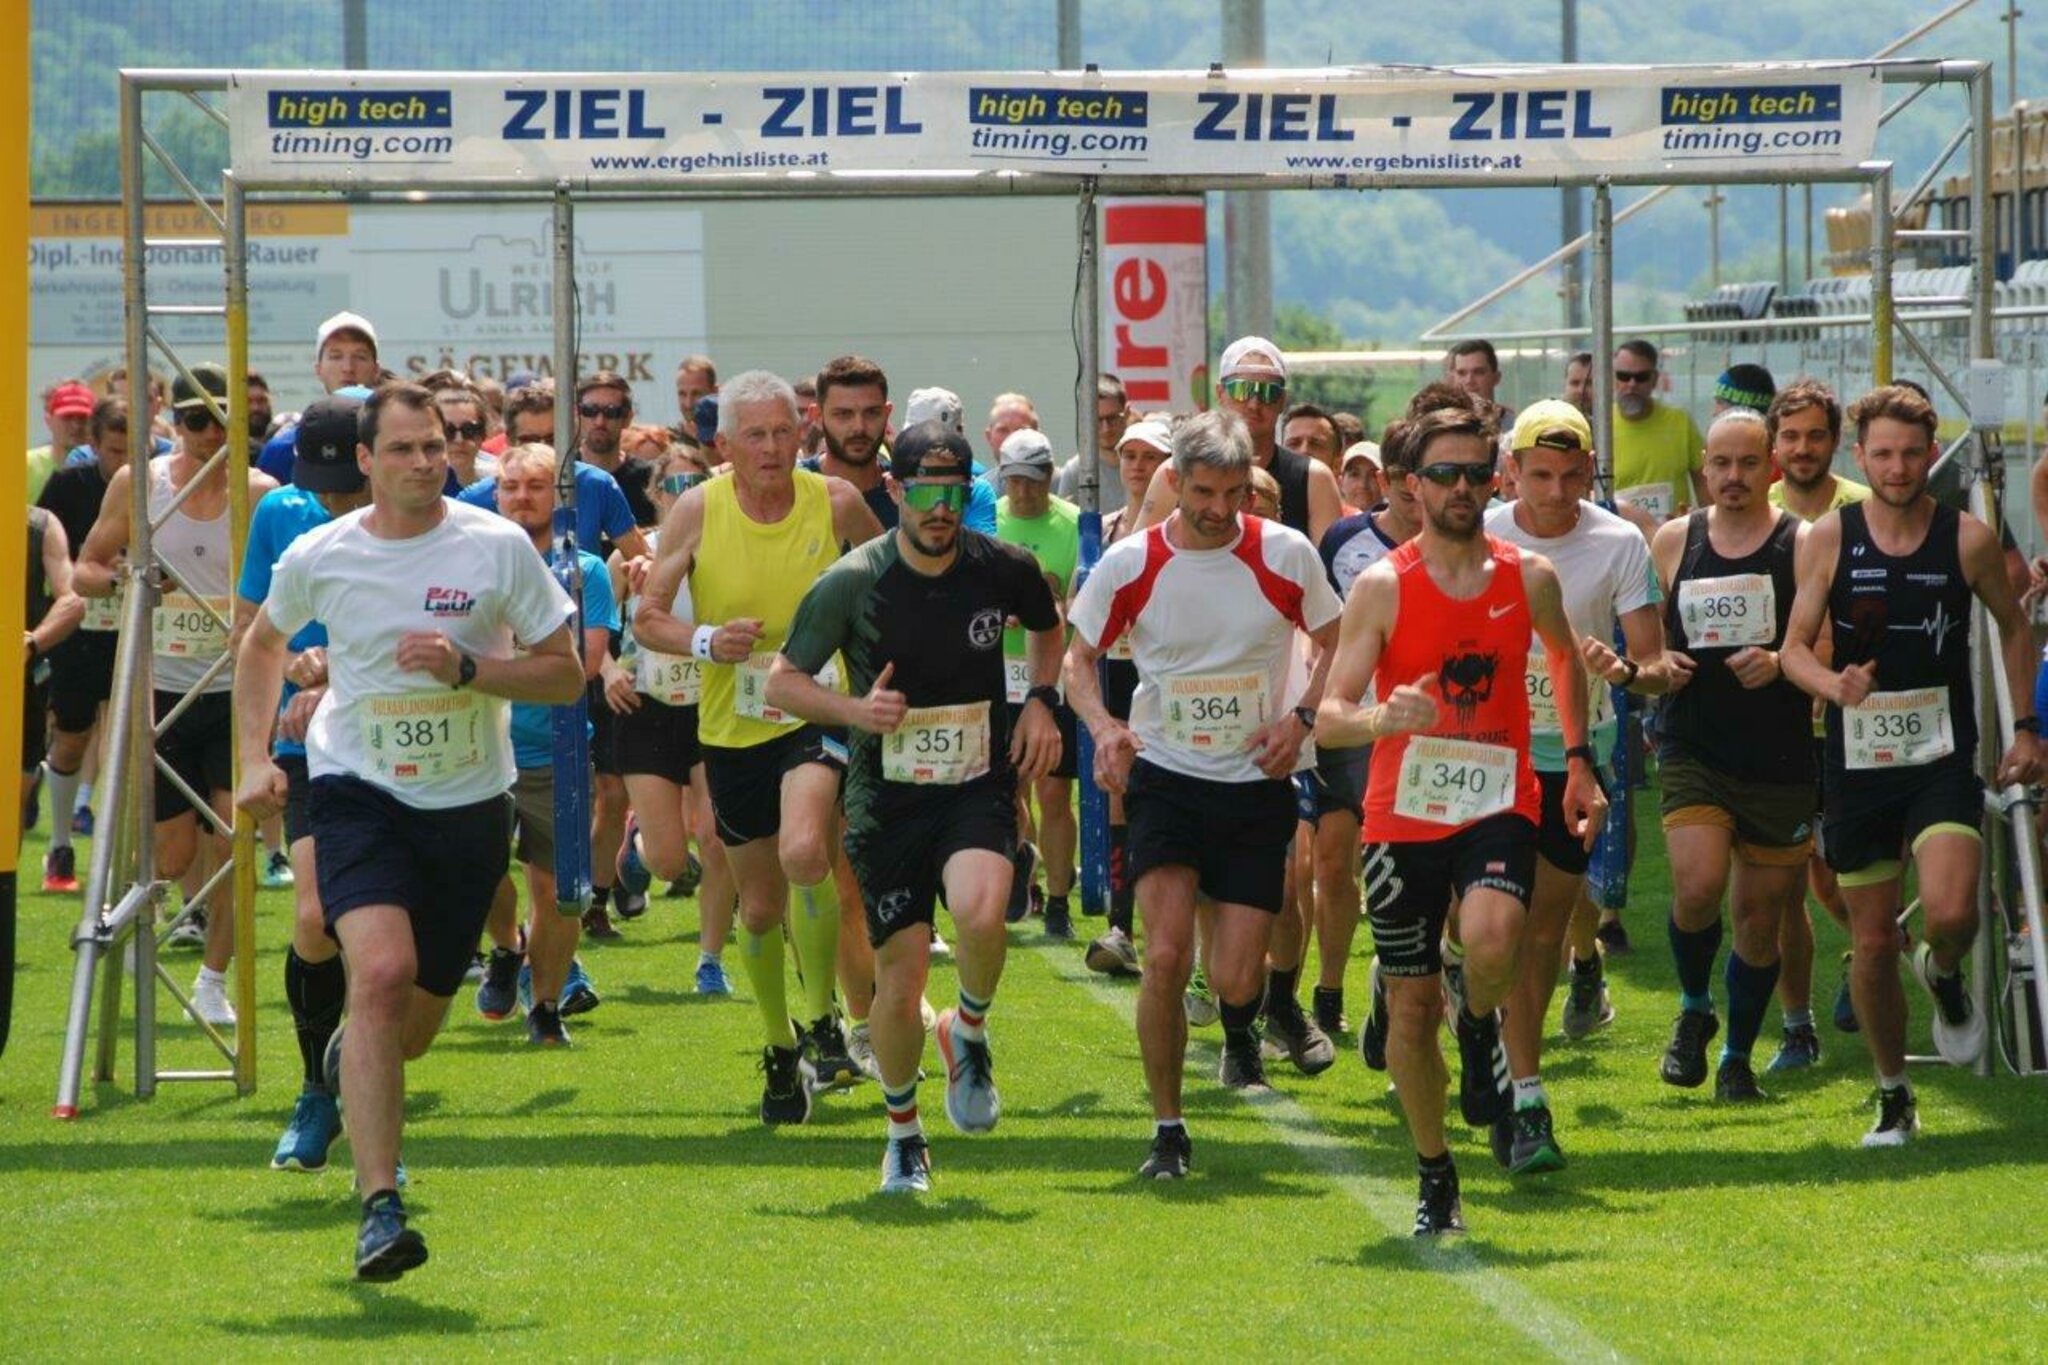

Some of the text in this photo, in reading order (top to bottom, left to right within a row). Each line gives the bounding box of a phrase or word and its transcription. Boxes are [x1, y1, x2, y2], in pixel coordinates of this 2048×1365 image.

[277, 97, 346, 125] high
[359, 98, 425, 119] tech
[502, 86, 922, 139] ZIEL - ZIEL
[978, 94, 1044, 122] high
[1058, 95, 1122, 118] tech
[1194, 90, 1611, 141] ZIEL - ZIEL
[1670, 92, 1737, 121] high
[1750, 90, 1815, 115] tech
[272, 132, 452, 159] timing.com
[972, 127, 1147, 155] timing.com
[1664, 127, 1841, 153] timing.com
[591, 151, 828, 172] www.ergebnisliste.at
[1286, 153, 1522, 171] www.ergebnisliste.at
[248, 243, 320, 263] Rauer
[1704, 595, 1747, 618] 363
[173, 612, 214, 633] 409
[1191, 696, 1241, 720] 364
[395, 718, 449, 747] 381
[1873, 713, 1922, 737] 336
[916, 729, 963, 752] 351
[1431, 763, 1486, 793] 340
